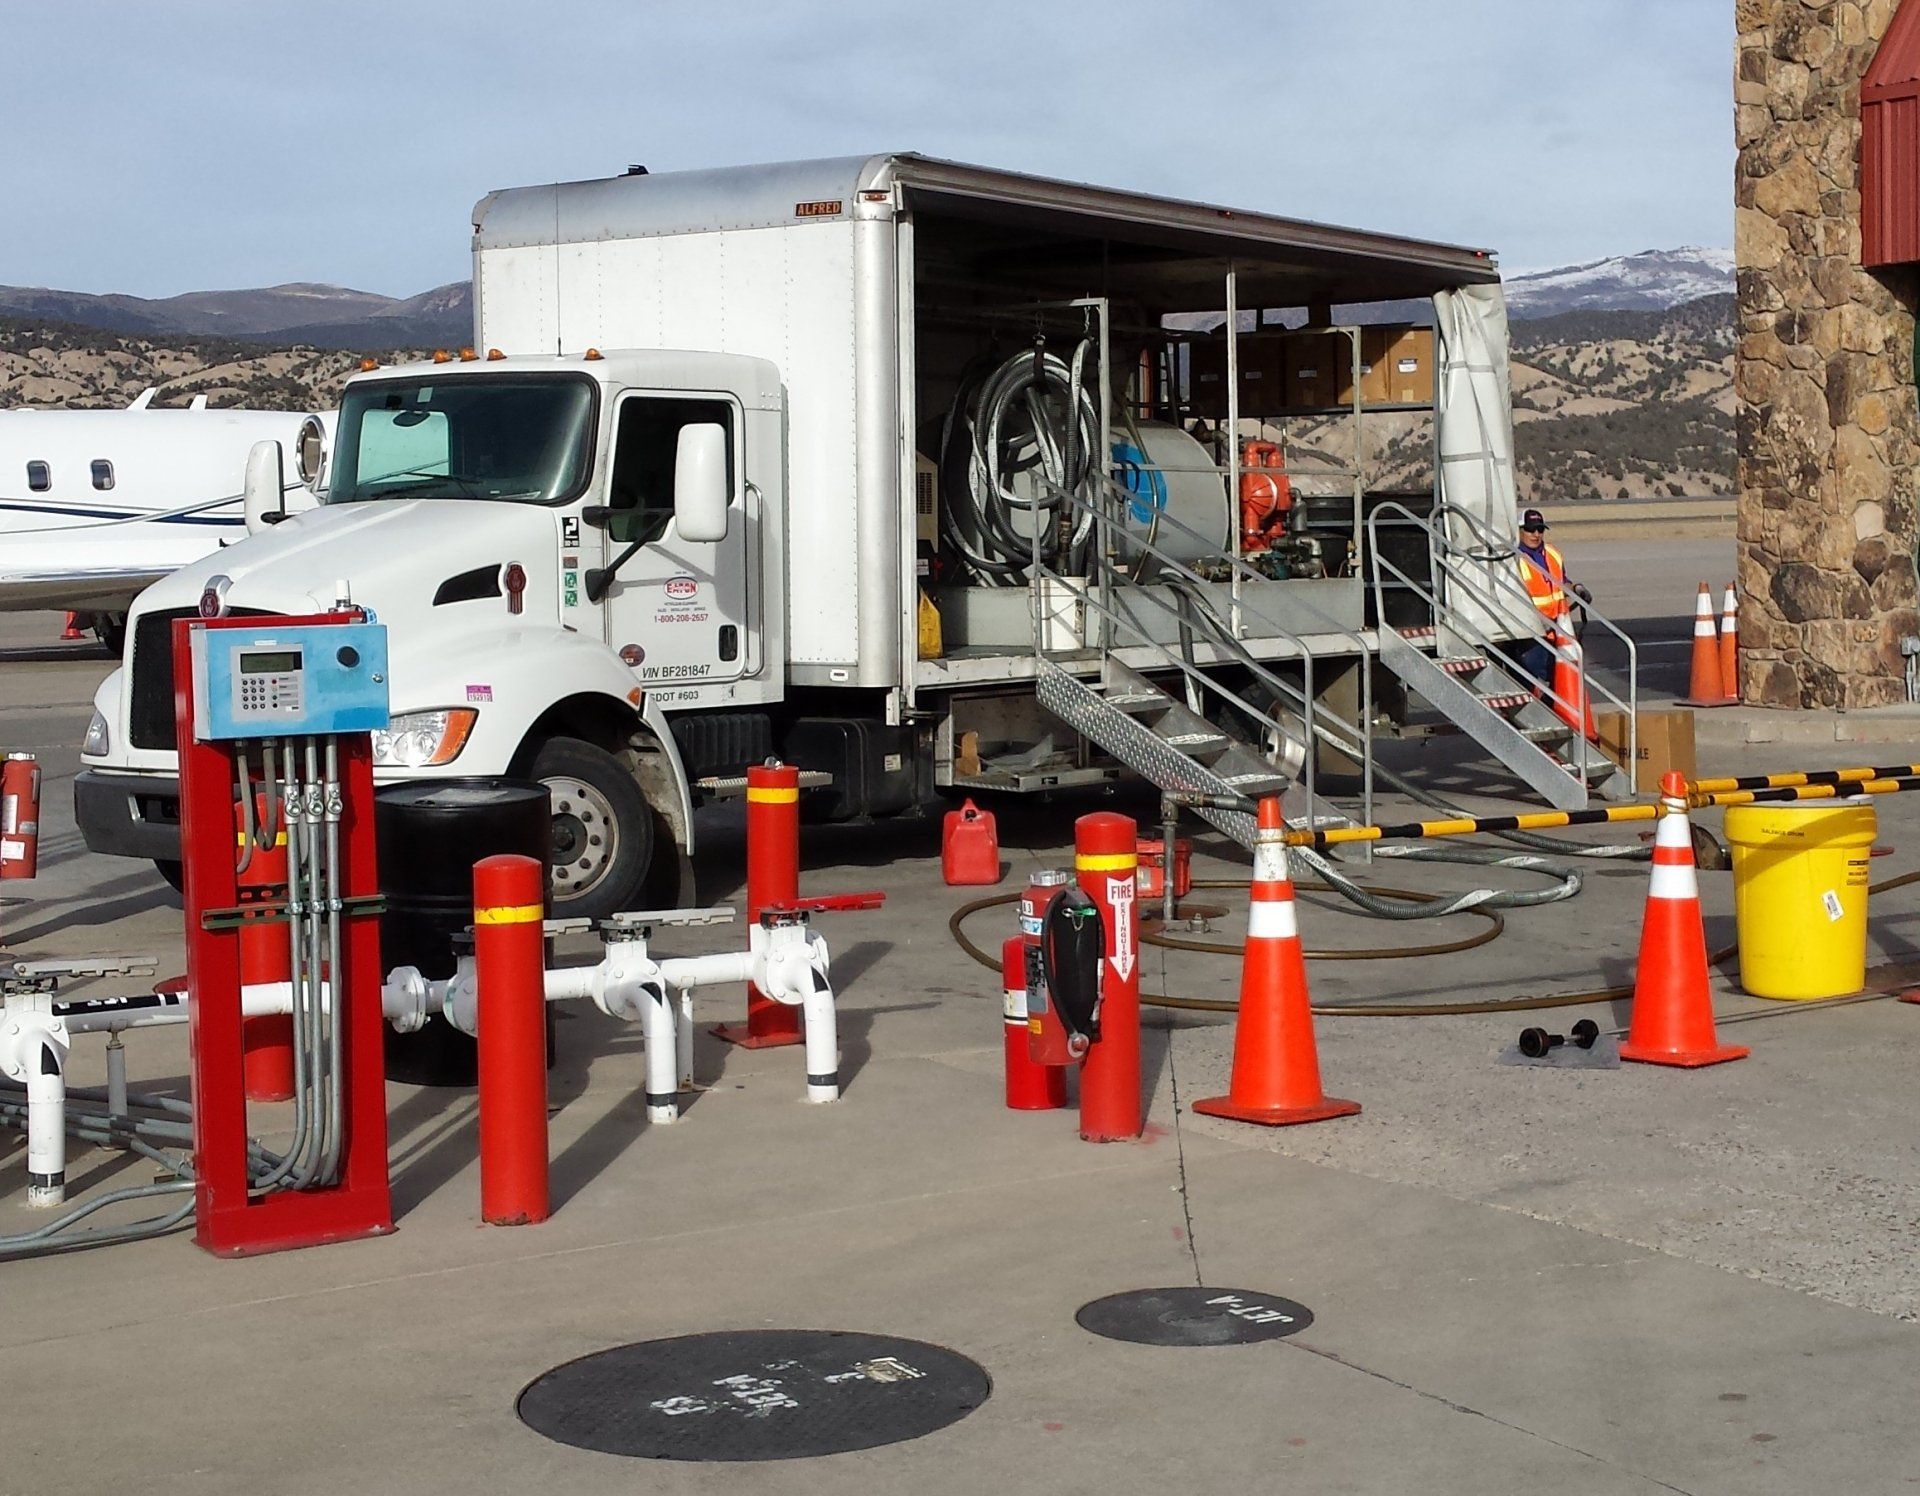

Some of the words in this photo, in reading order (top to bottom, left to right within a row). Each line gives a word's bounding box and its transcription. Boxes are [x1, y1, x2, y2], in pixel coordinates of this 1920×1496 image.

[798, 202, 841, 216] ALFRED
[642, 667, 660, 679] VIN
[662, 664, 711, 678] BF281847
[678, 691, 699, 700] #603
[1111, 885, 1132, 900] FIRE
[1205, 1295, 1294, 1324] JET-A
